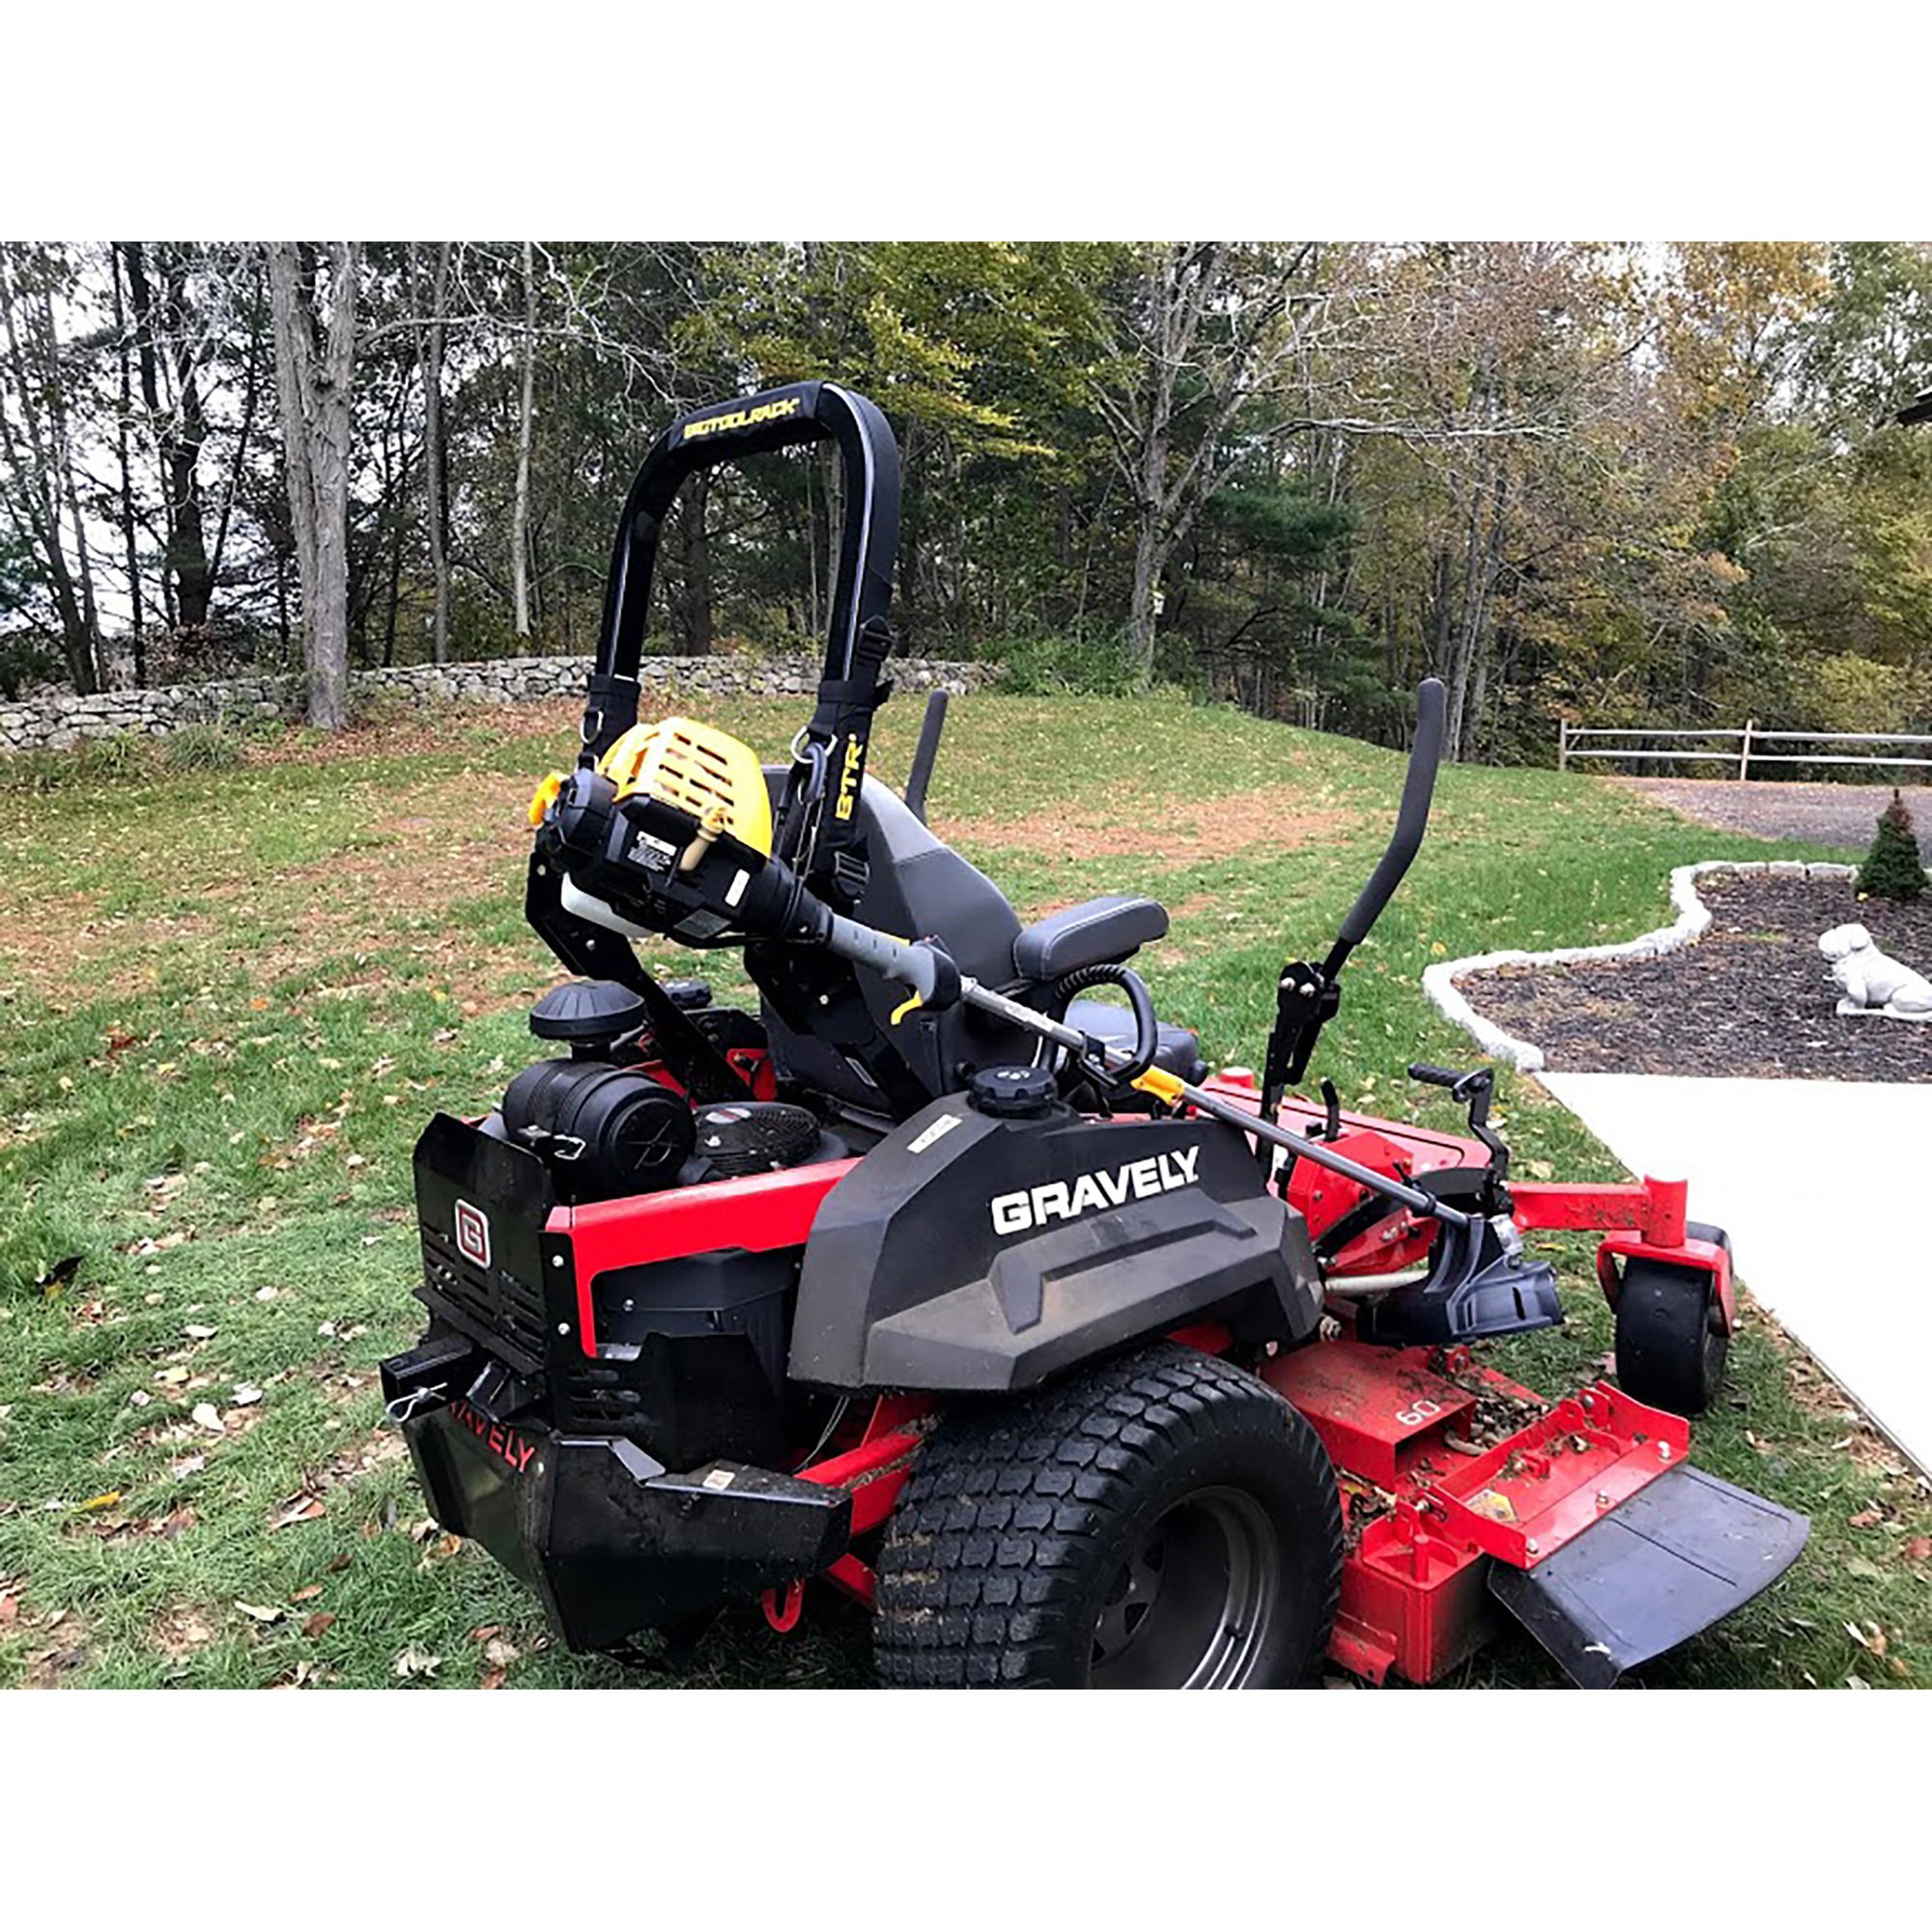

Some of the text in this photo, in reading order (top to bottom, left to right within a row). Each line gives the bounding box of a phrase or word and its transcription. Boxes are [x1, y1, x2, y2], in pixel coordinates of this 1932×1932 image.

[835, 737, 864, 820] BTR
[990, 1146, 1199, 1235] GRAVELY
[462, 1213, 482, 1254] G
[1396, 1400, 1440, 1426] 60
